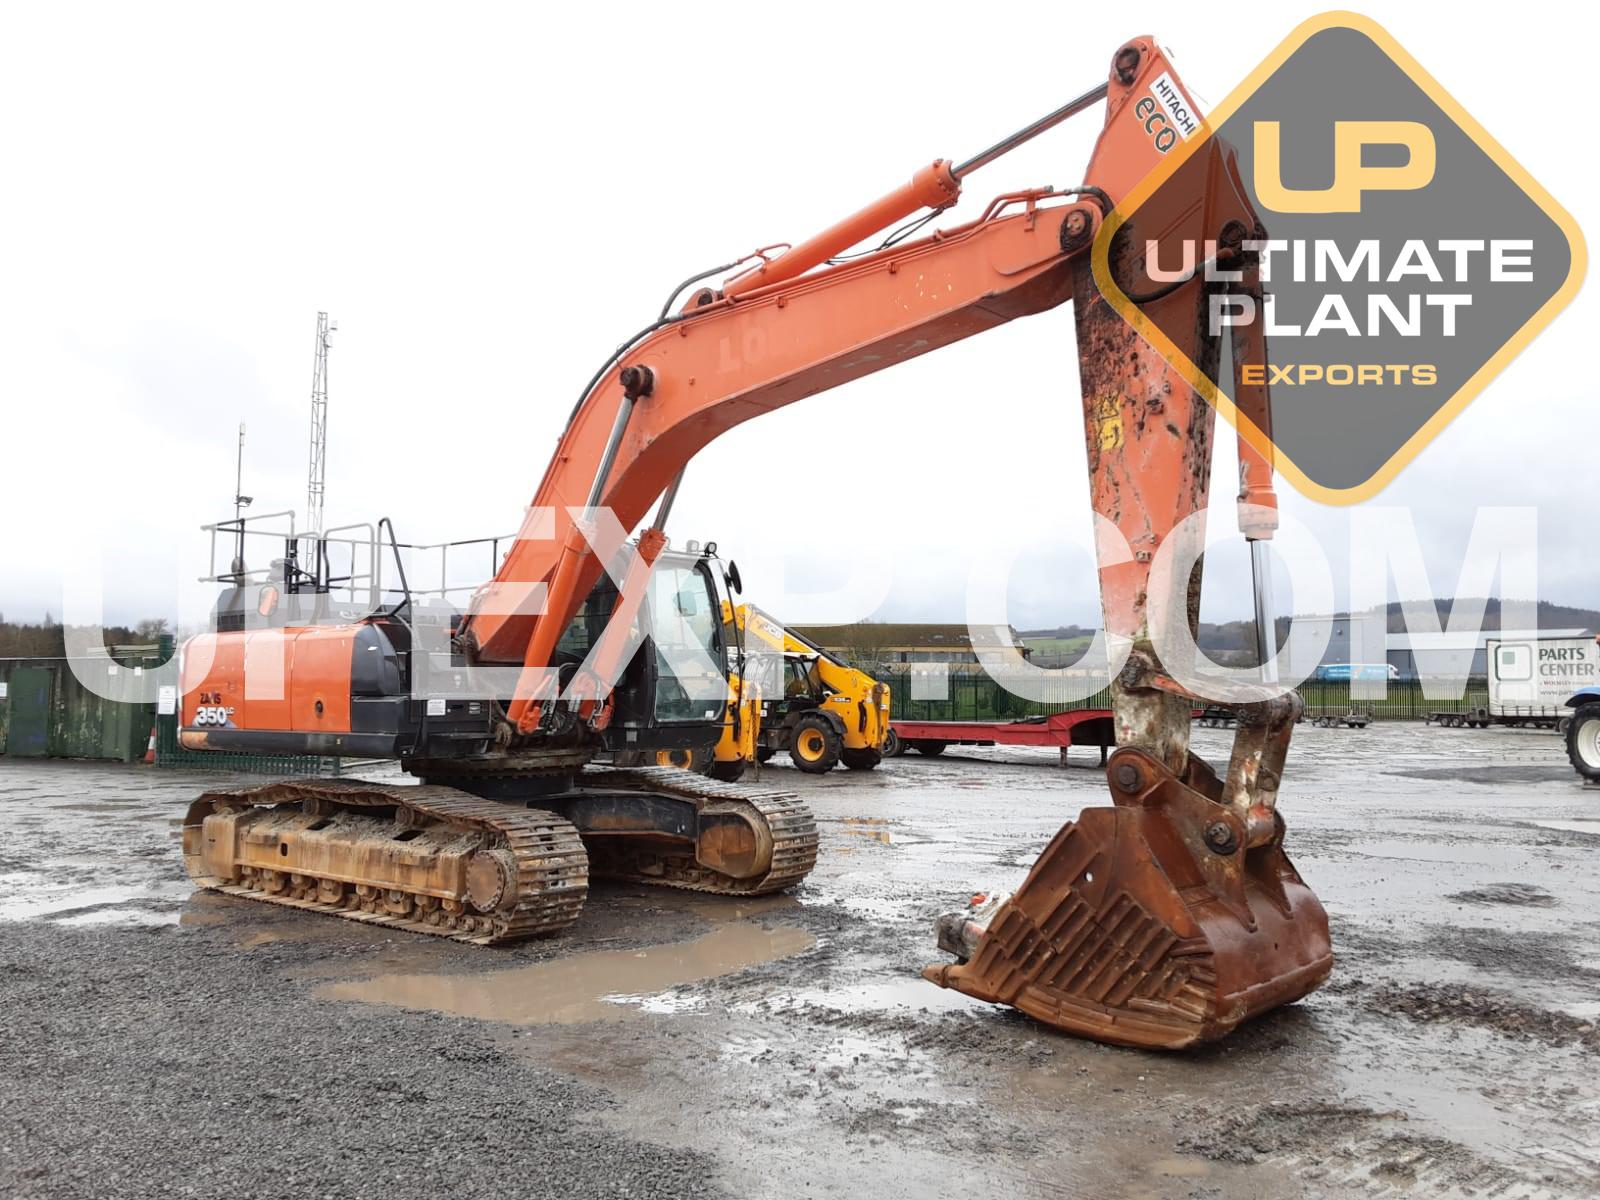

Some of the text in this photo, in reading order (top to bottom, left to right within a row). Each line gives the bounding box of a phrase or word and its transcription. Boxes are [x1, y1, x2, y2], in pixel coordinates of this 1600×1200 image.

[1156, 79, 1197, 136] HITACHI
[1538, 647, 1585, 661] PARTS
[1539, 662, 1595, 677] CENTER
